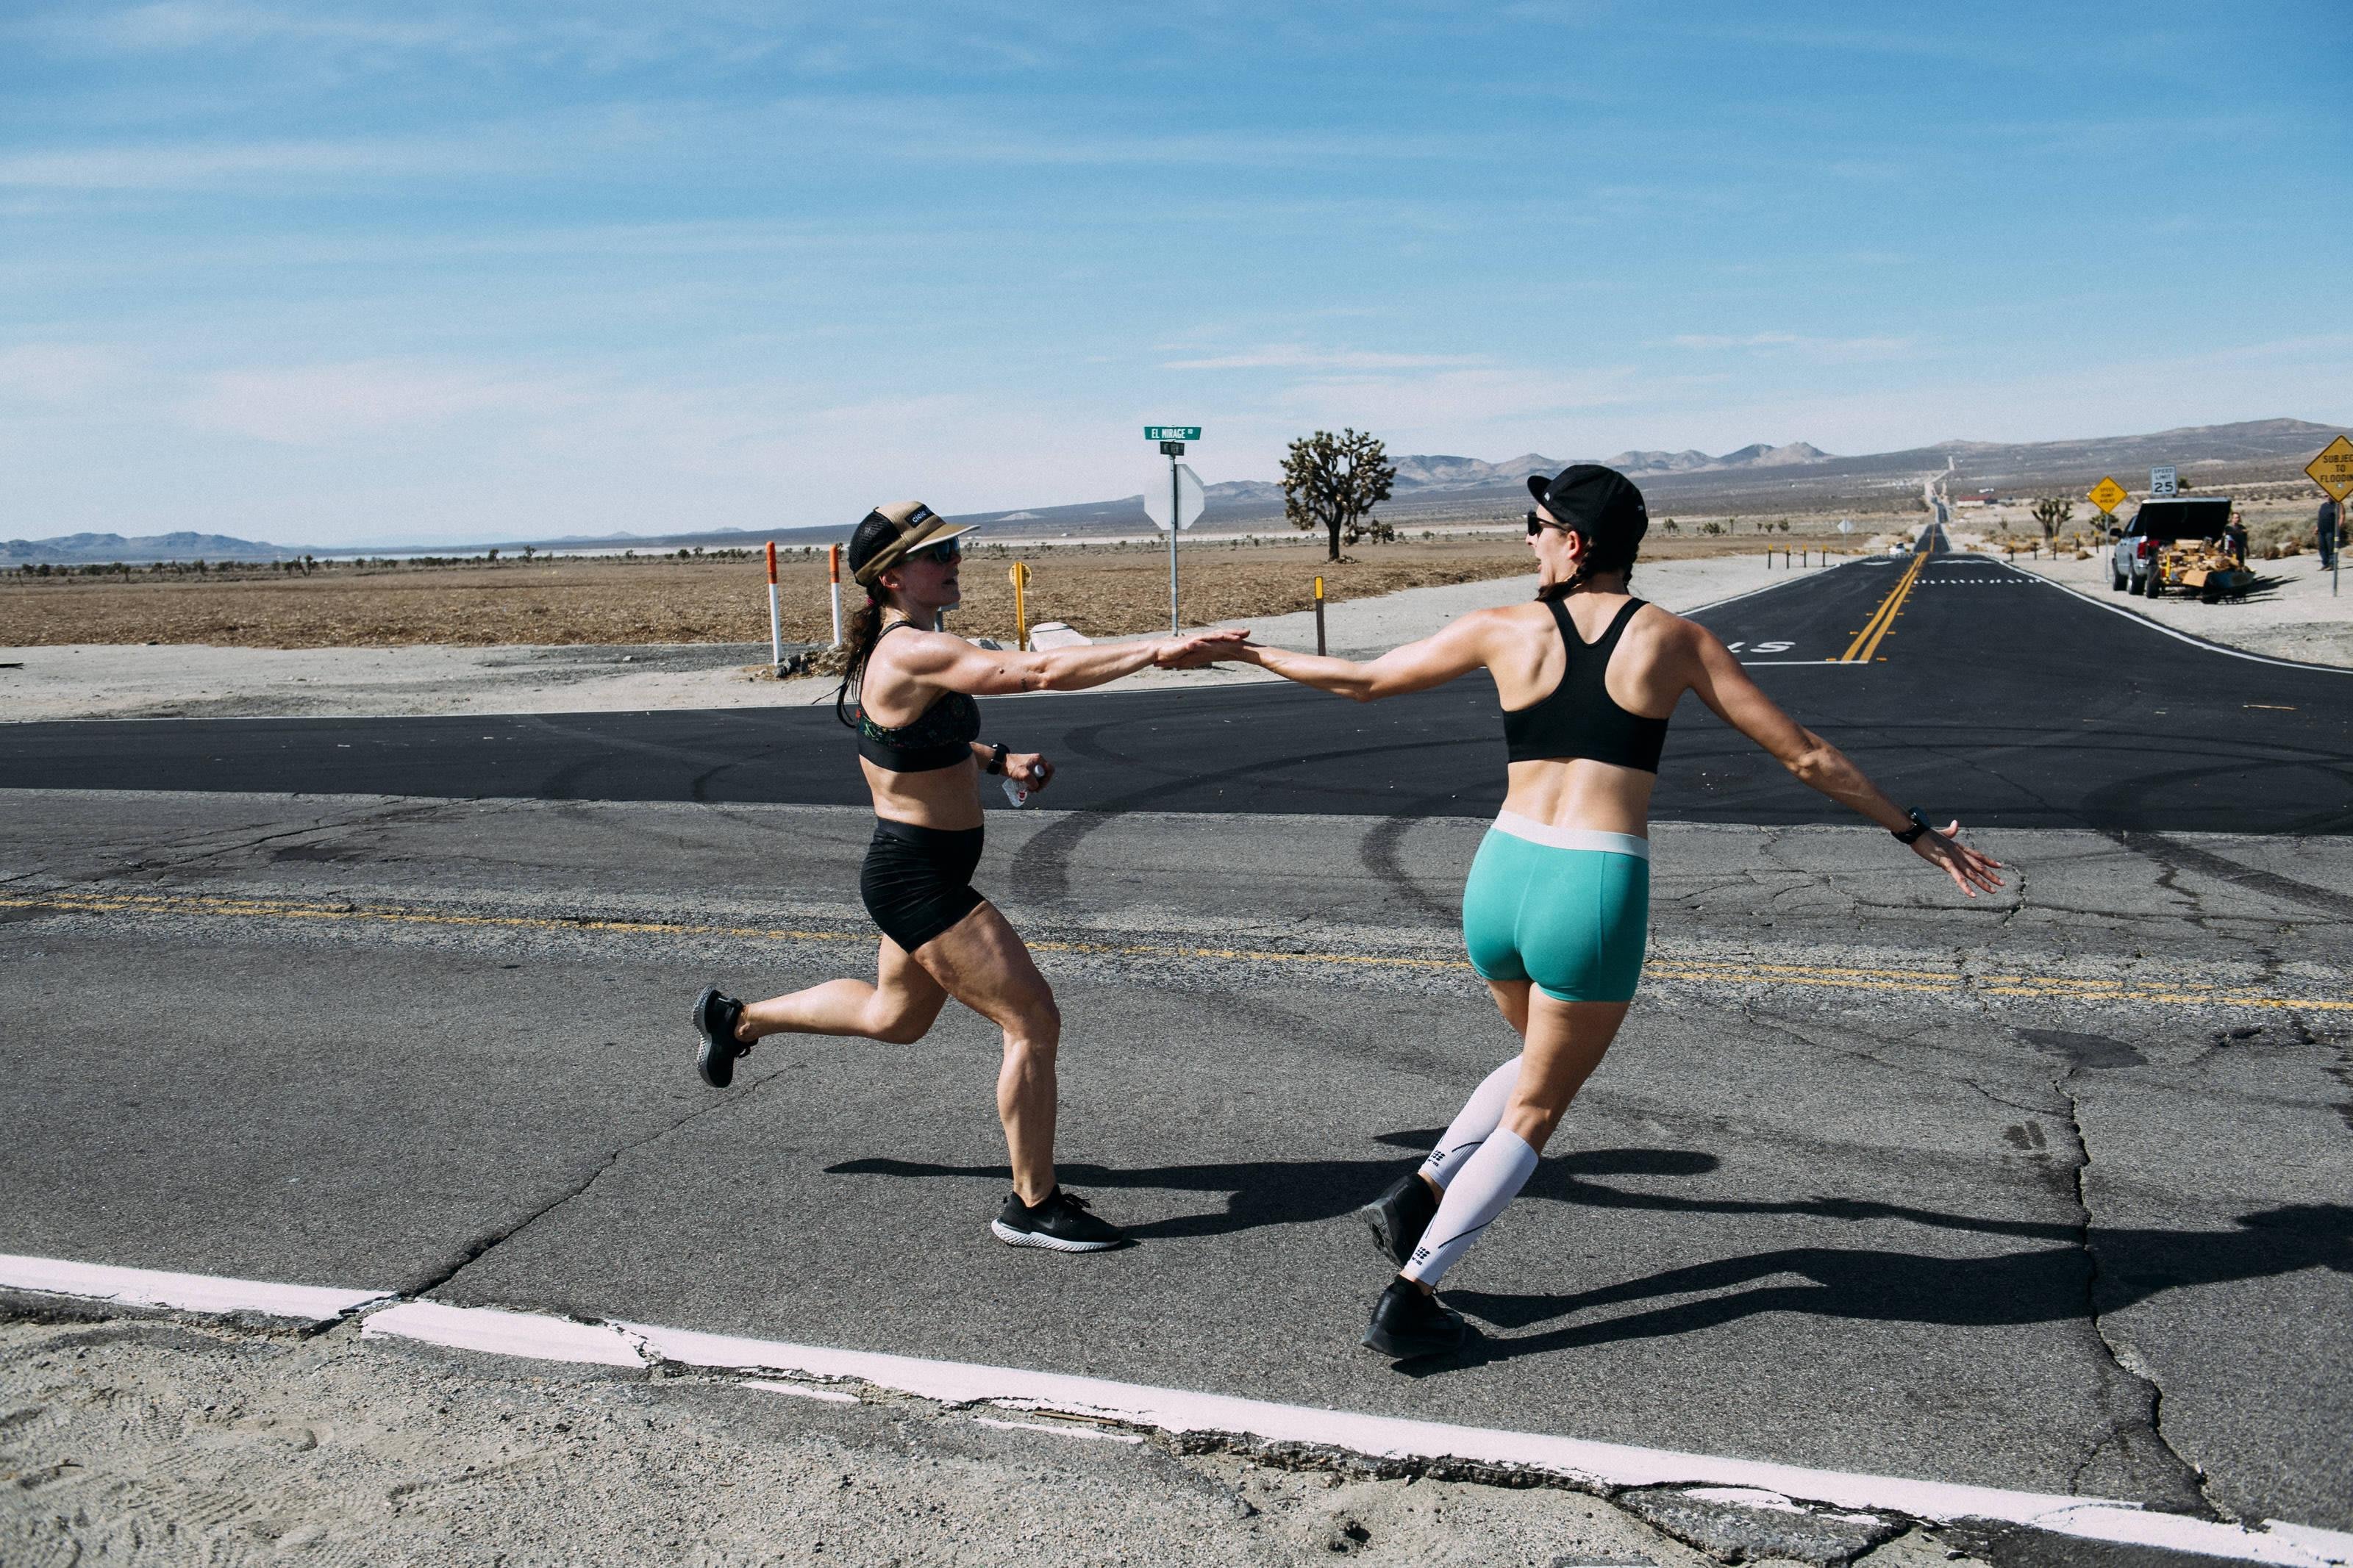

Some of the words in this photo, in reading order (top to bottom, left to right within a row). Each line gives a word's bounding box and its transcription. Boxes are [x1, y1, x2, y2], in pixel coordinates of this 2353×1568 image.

[1151, 429, 1160, 438] EL
[1162, 429, 1186, 439] MIRAGE
[2323, 454, 2353, 463] SUBJEC
[2335, 464, 2346, 473] TO
[2320, 474, 2353, 483] FLOODIN
[2154, 482, 2174, 493] 25
